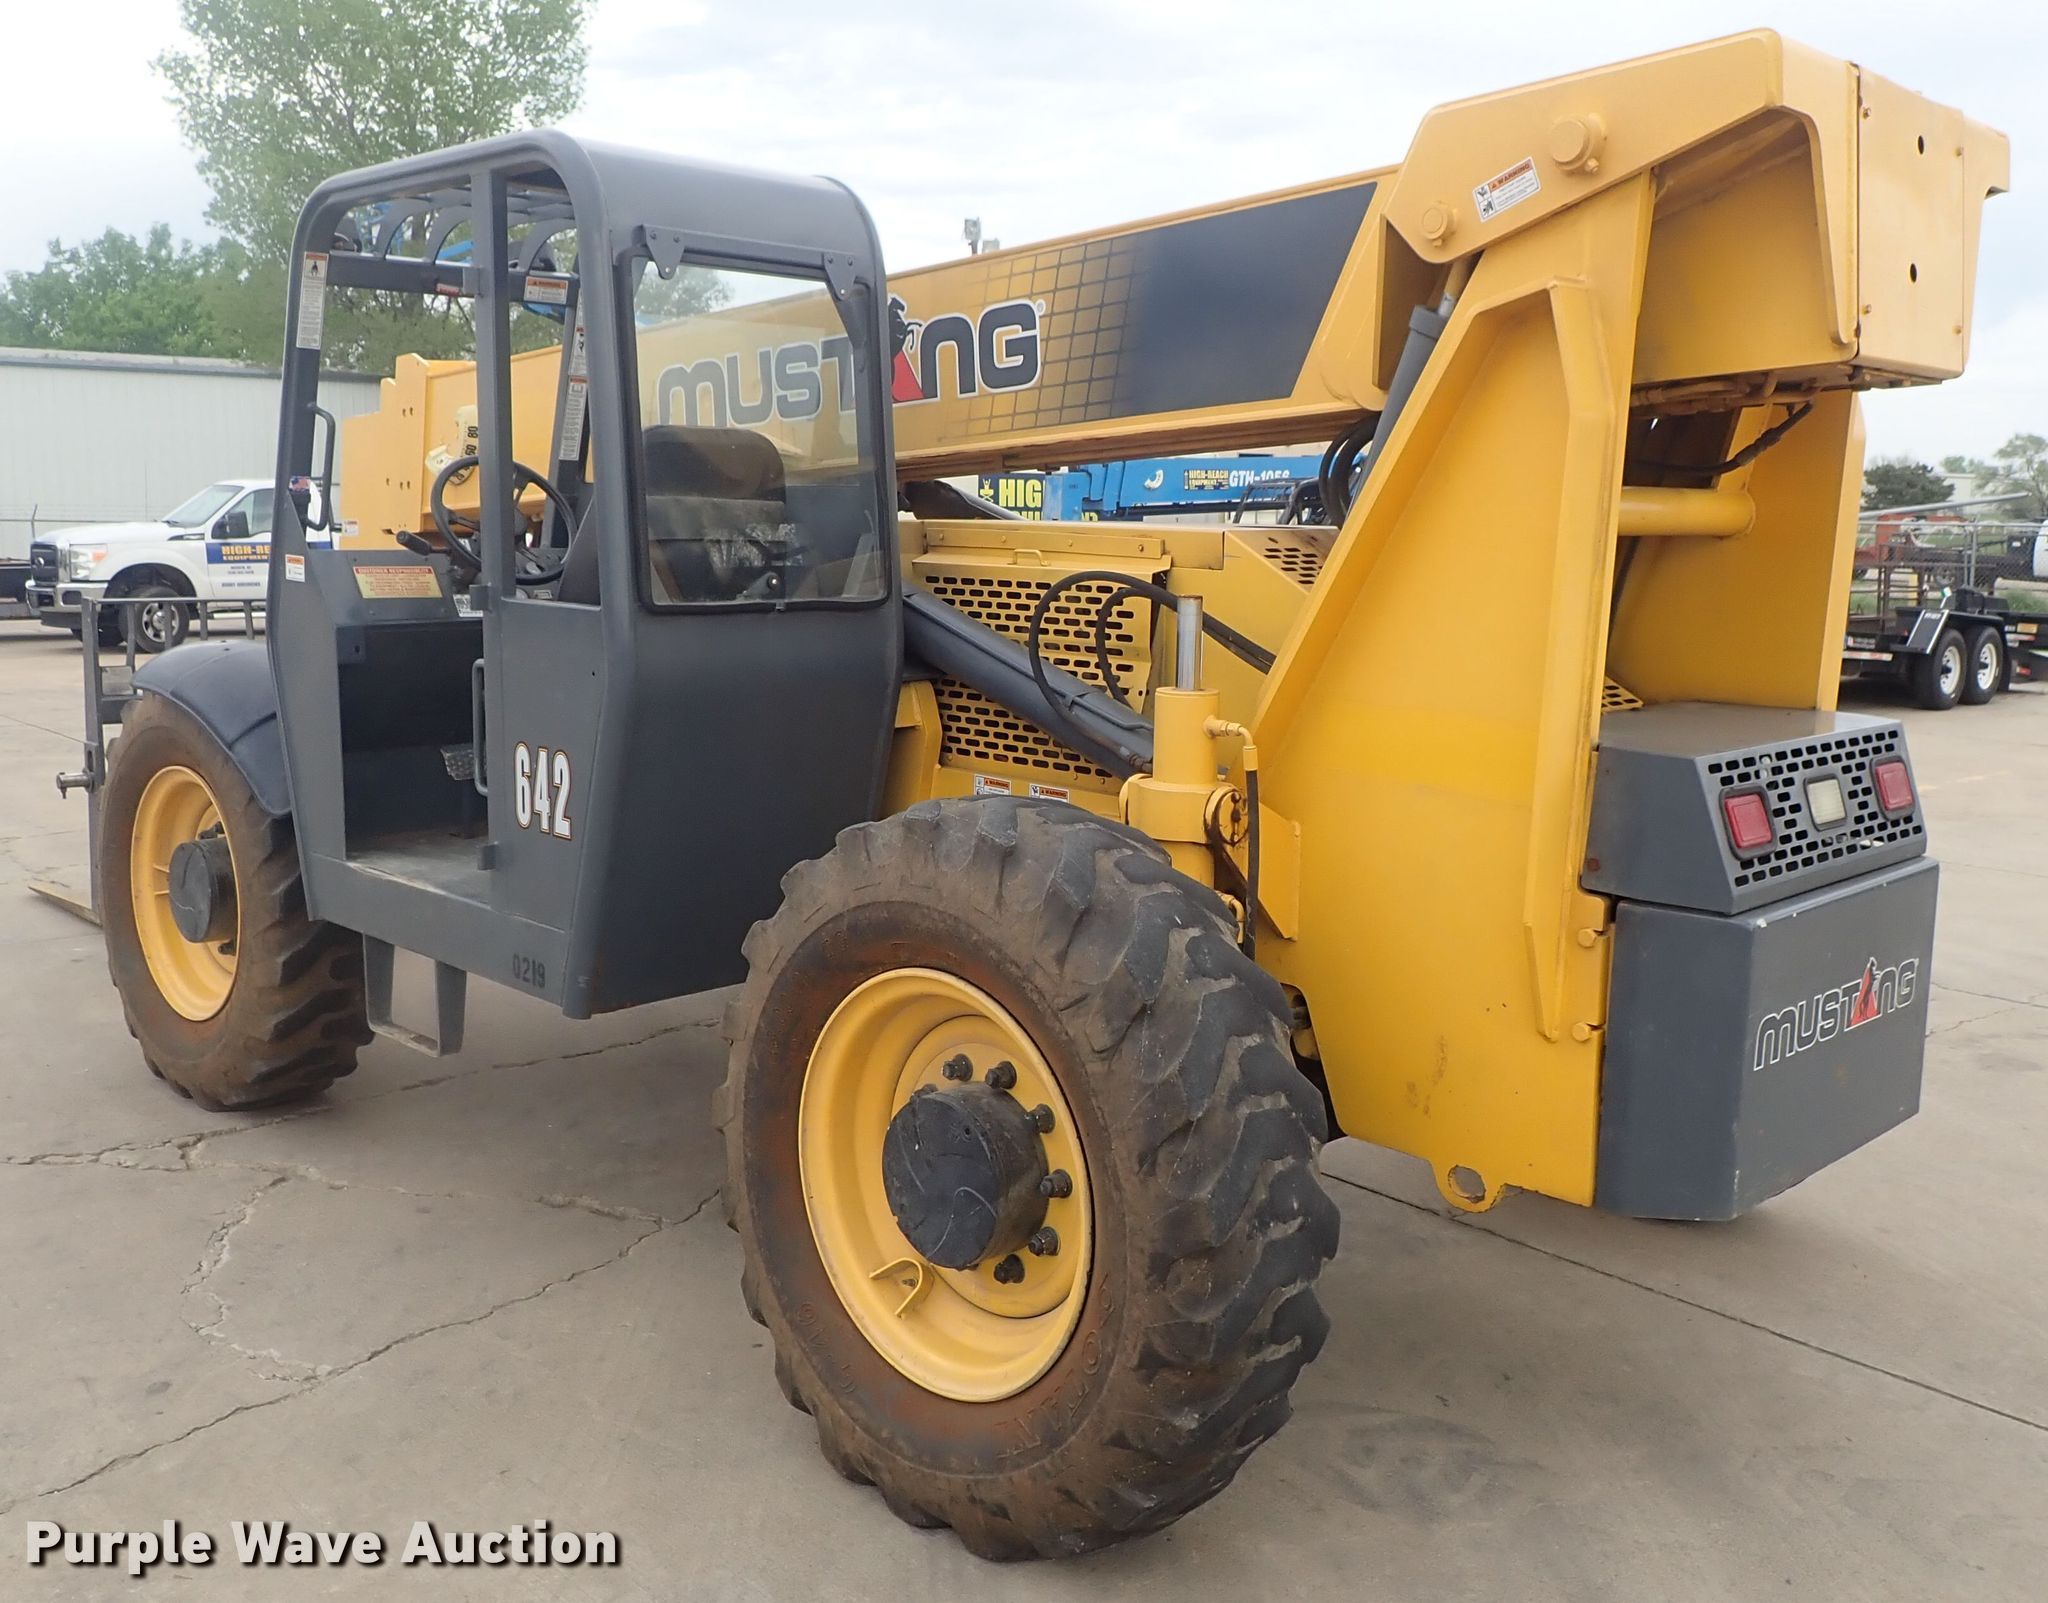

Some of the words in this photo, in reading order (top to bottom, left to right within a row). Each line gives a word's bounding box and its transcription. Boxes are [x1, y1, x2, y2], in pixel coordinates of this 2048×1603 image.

[1498, 163, 1530, 185] WARNING
[467, 426, 478, 438] 80
[1189, 470, 1228, 478] HIGH-REACH
[999, 479, 1046, 508] HIG
[221, 545, 272, 555] HIGH-RE
[513, 741, 572, 840] 642
[512, 953, 547, 988] 0219
[1754, 957, 1918, 1071] MUSTANG
